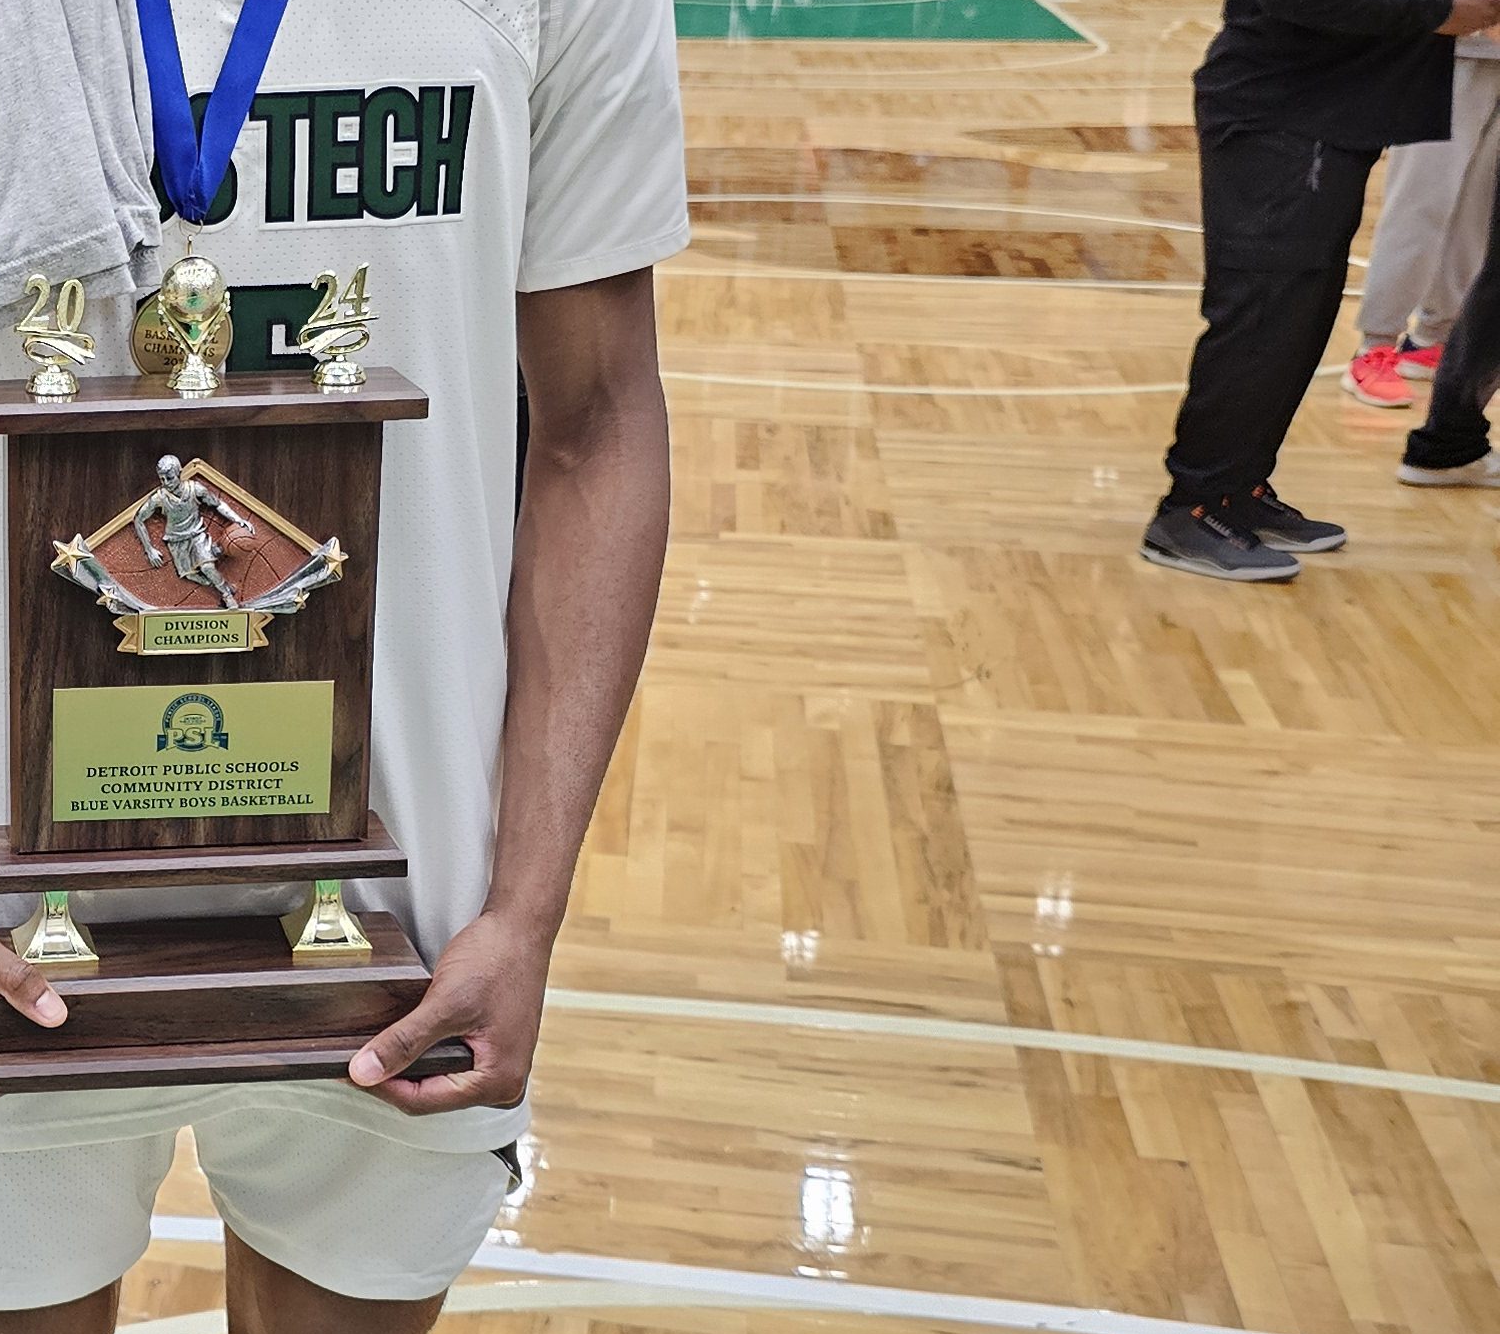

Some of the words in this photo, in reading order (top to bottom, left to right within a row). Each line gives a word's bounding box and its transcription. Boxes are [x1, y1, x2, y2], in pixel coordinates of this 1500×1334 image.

[249, 85, 475, 224] TECH
[308, 262, 372, 324] 24
[16, 273, 85, 333] 20
[164, 620, 229, 632] DIVISION
[154, 633, 240, 645] CHAMPIONS
[166, 727, 222, 750] PSL
[86, 765, 158, 778] DETROIT
[163, 763, 221, 776] PUBLIC
[225, 761, 299, 773] SCHOOLS
[101, 780, 202, 794] COMMUNITY
[208, 778, 283, 791] DISTRICT
[71, 799, 109, 812] BLUE
[112, 797, 175, 810] VARSITY
[179, 796, 216, 808] BOYS
[221, 794, 314, 807] BASKETBALL
